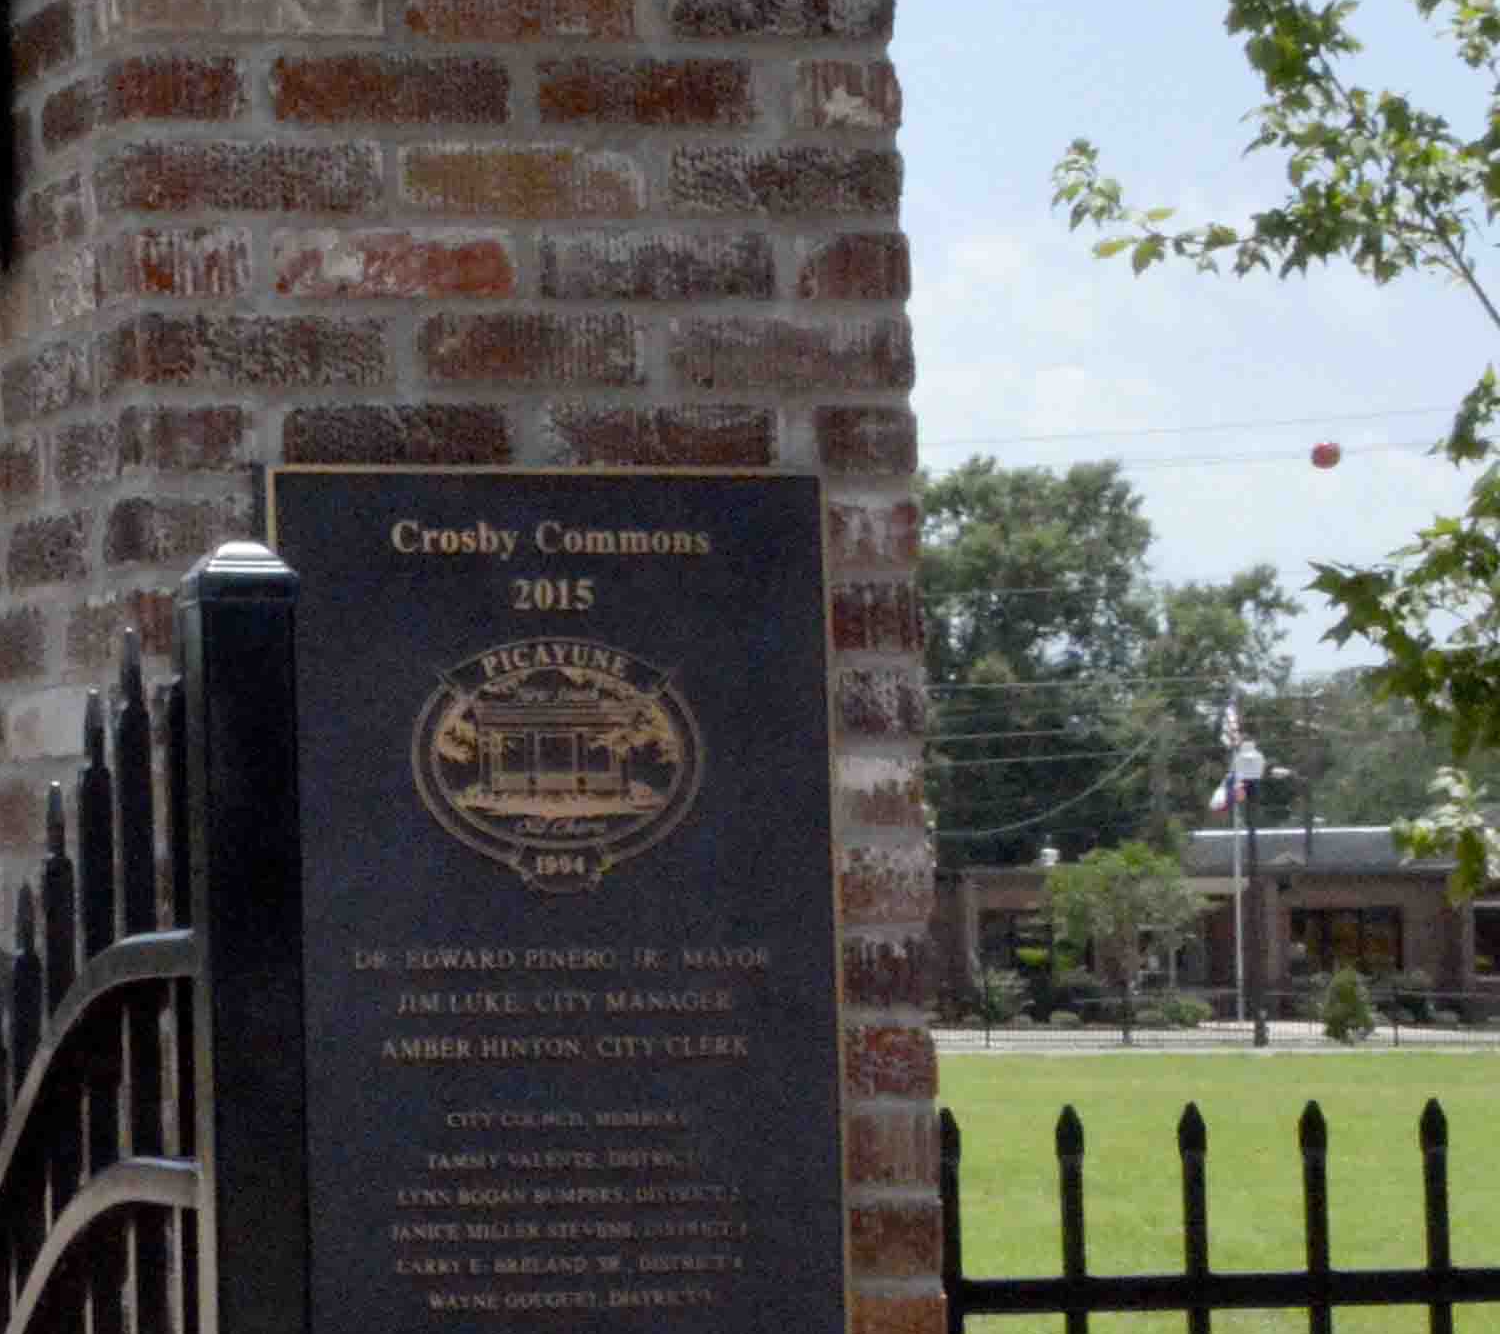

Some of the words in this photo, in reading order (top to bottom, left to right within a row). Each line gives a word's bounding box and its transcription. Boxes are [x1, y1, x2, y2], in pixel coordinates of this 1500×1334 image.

[390, 519, 520, 562] Crosby
[534, 519, 712, 555] Commons
[513, 578, 597, 611] 2015
[481, 643, 629, 679] PICAYUNE
[405, 947, 517, 970] EDWARD
[682, 946, 772, 969] MAYOR
[397, 993, 440, 1015] JIM
[533, 991, 596, 1013] CITY
[604, 989, 736, 1013] MANAGER
[381, 1036, 473, 1060] AMBER
[596, 1035, 653, 1058] CITY
[663, 1034, 750, 1058] CLERK
